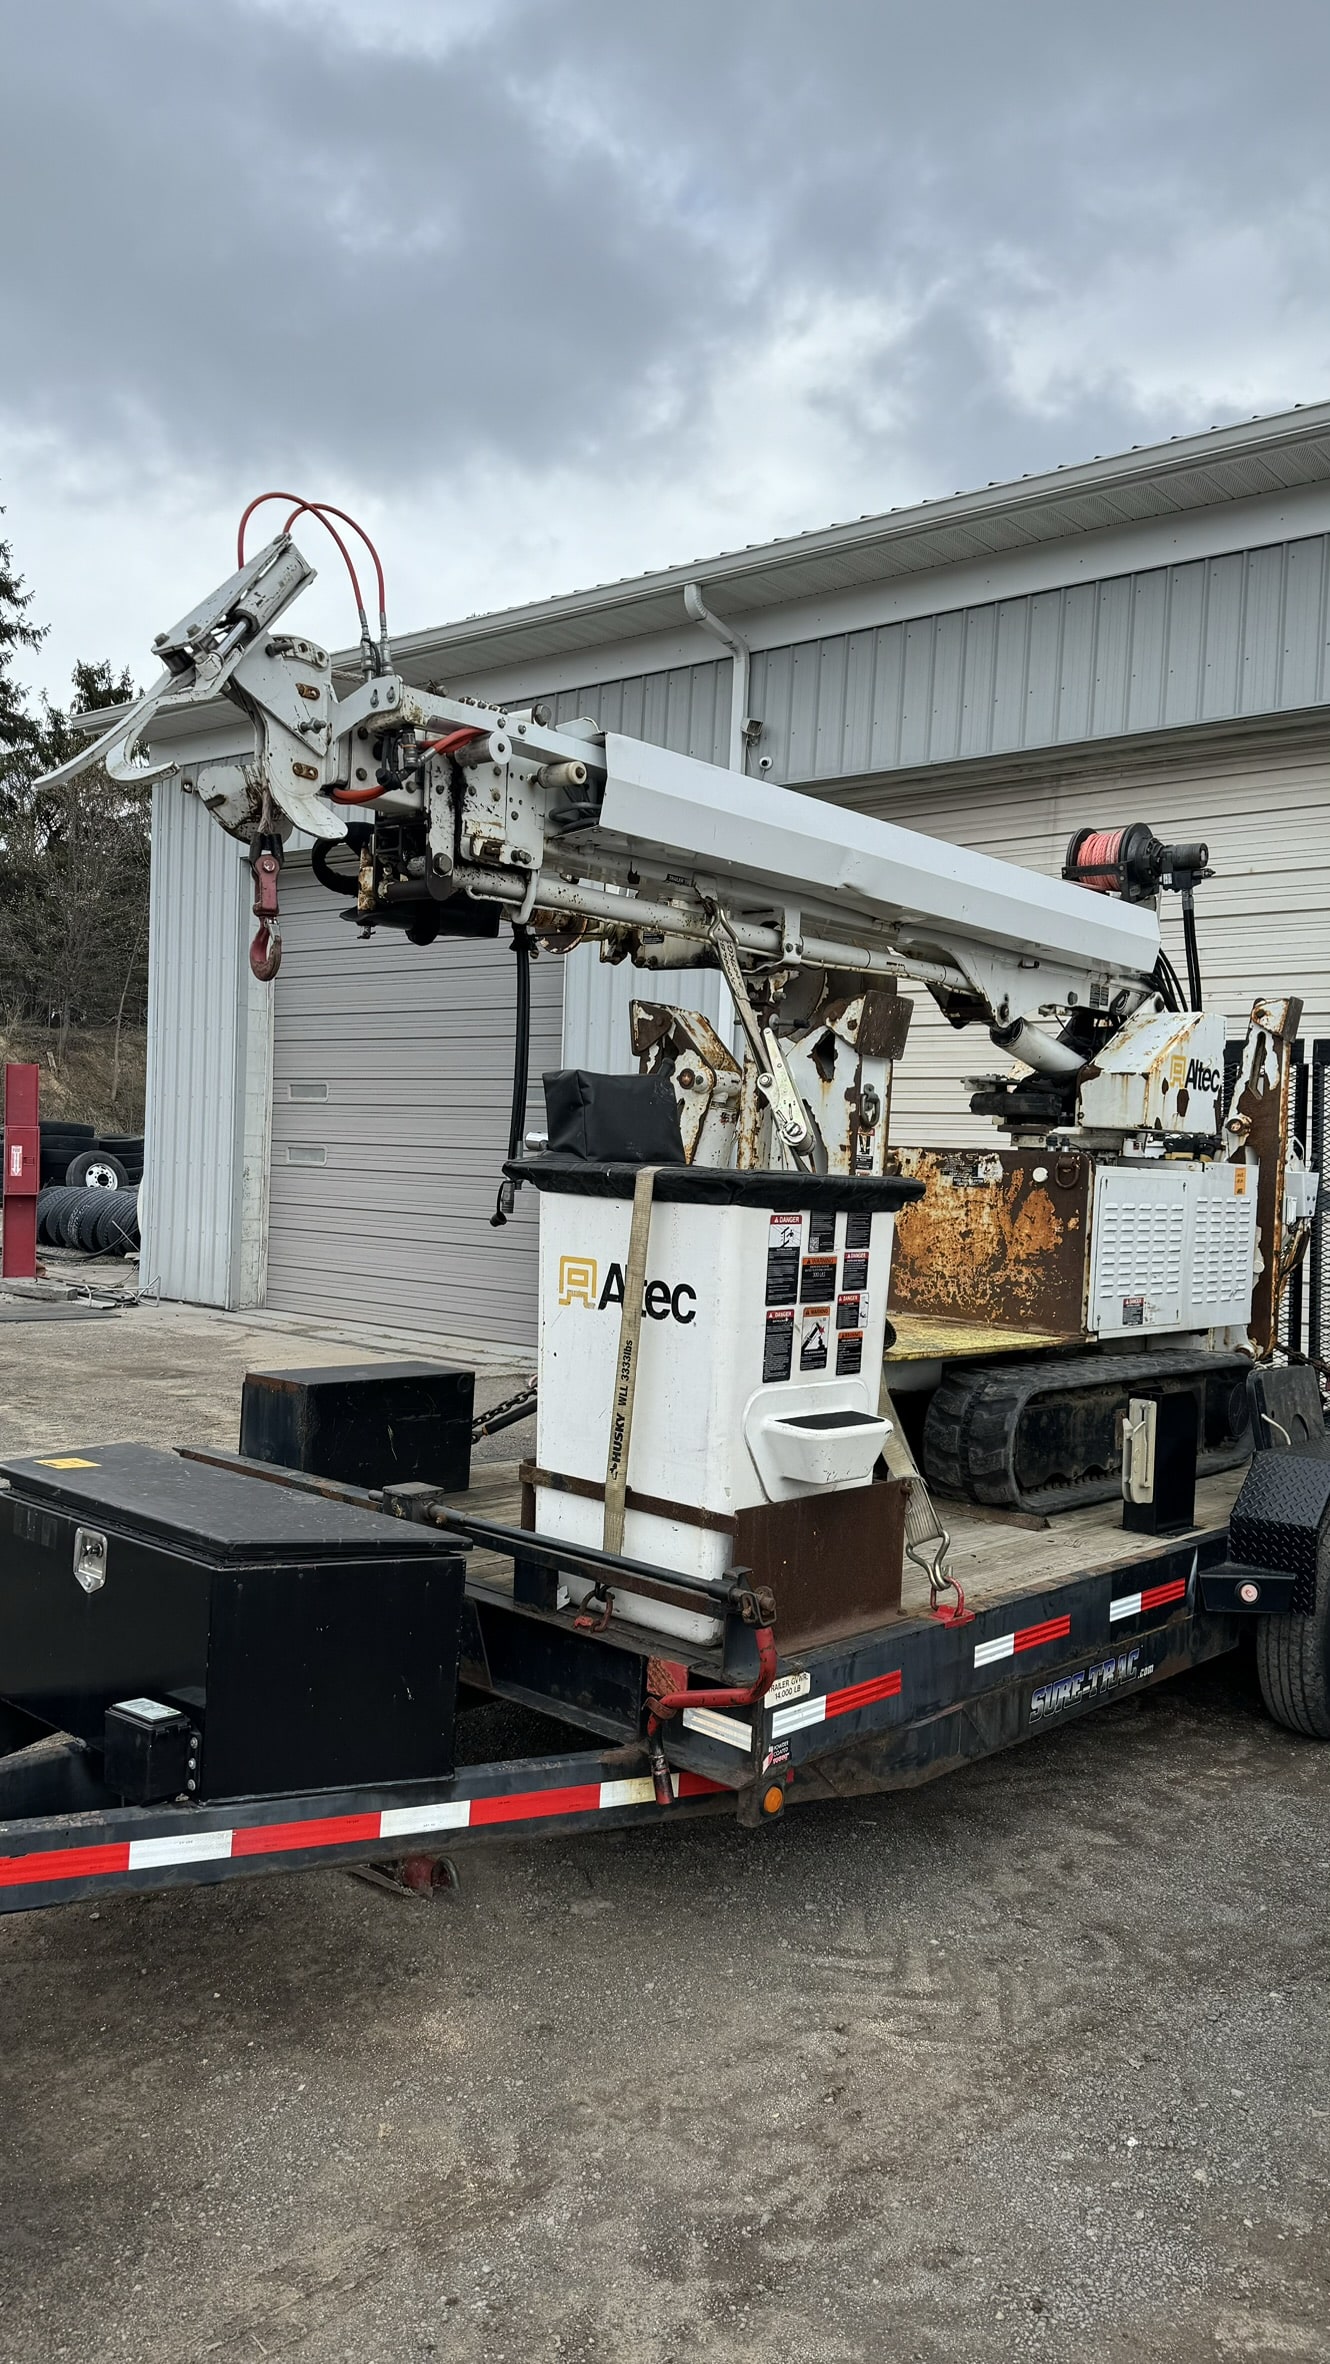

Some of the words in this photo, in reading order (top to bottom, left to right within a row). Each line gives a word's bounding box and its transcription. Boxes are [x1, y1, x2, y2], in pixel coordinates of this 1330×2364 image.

[1185, 1058, 1220, 1092] Altec
[598, 1262, 697, 1324] Aec
[620, 1339, 633, 1382] 3333lbs
[617, 1385, 629, 1407] WLL
[611, 1412, 626, 1463] HUSKY
[1029, 1647, 1140, 1725] SURE-TRAC
